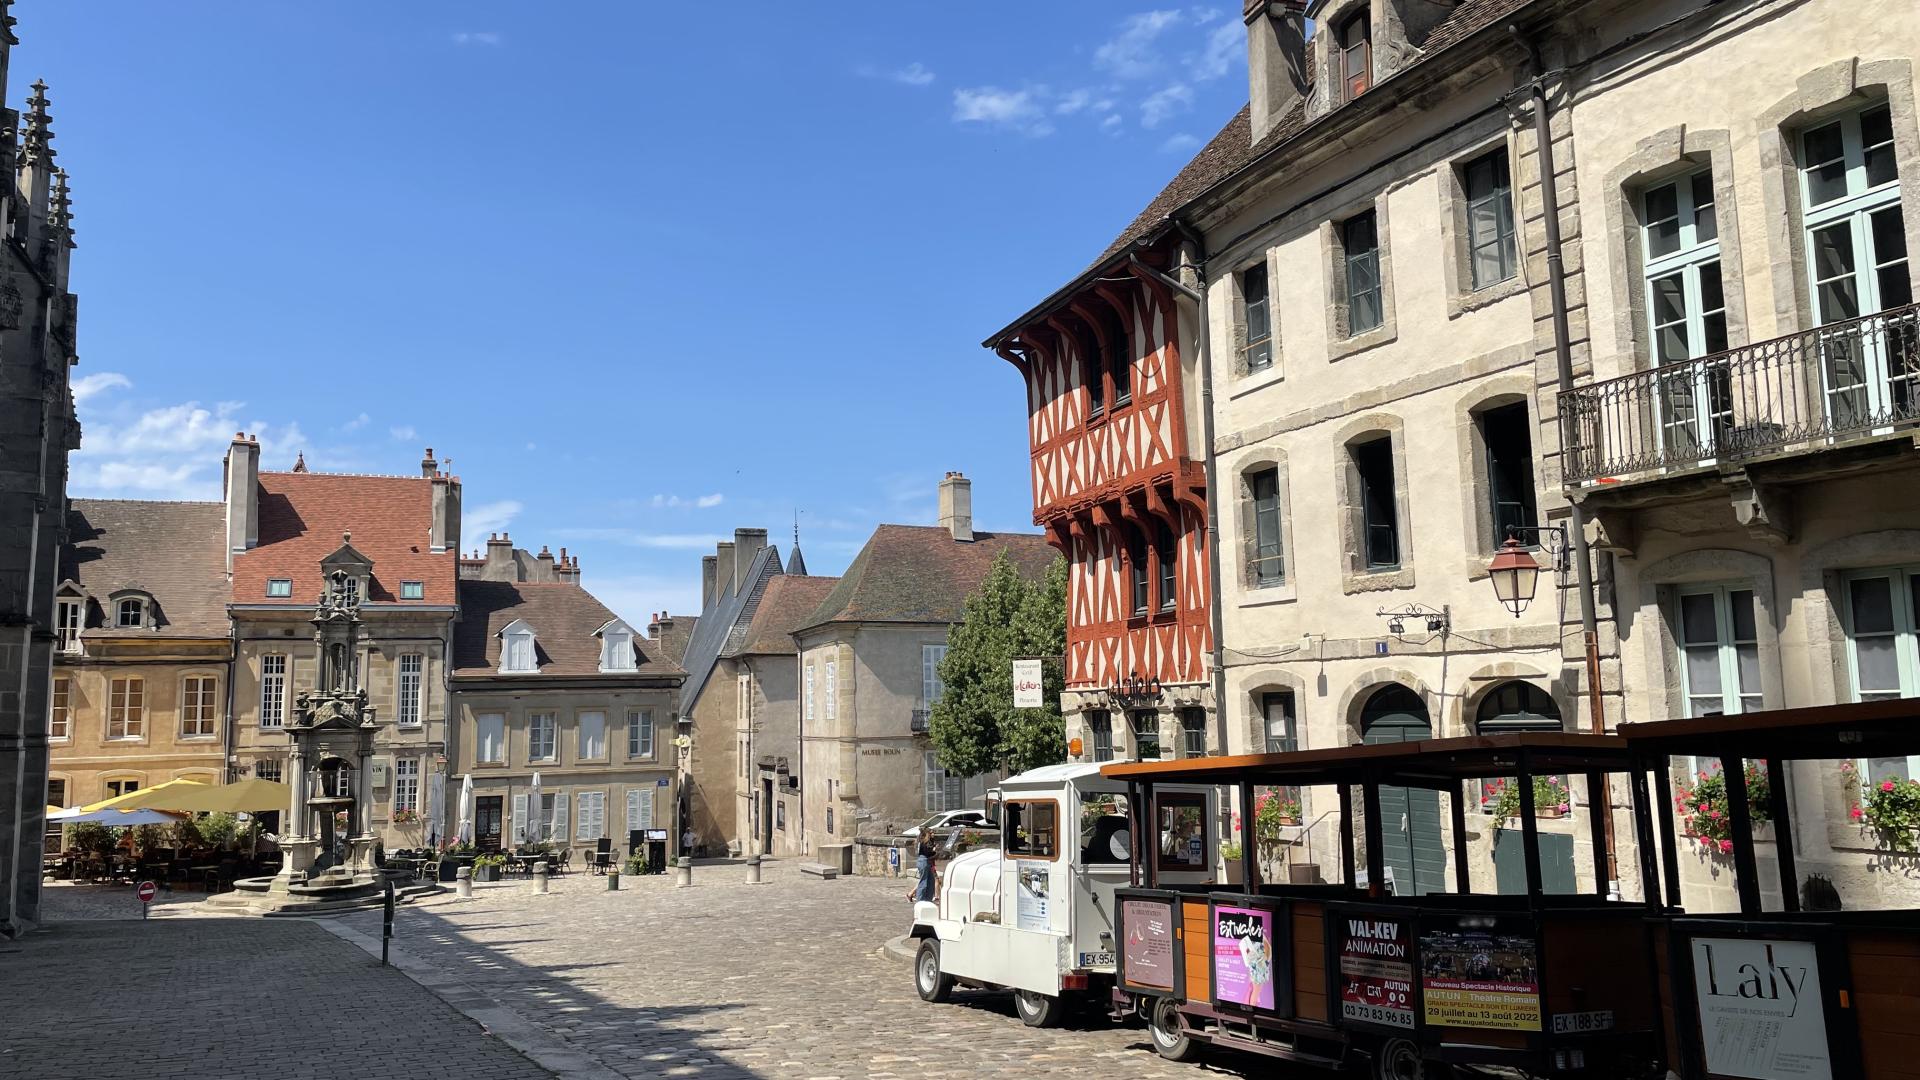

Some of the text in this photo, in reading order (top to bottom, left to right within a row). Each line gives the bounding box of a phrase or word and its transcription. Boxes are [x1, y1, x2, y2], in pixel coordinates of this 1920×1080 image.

[1219, 916, 1264, 938] Estivales
[1348, 919, 1398, 940] VAL-KEV
[1345, 940, 1404, 958] ANIMATION
[1384, 981, 1410, 992] AUTUN
[1430, 981, 1531, 993] Nouveau Spectacle Historique
[1701, 944, 1807, 1018] Laly
[1427, 992, 1460, 1000] AUTUN
[1503, 995, 1537, 1004] Romain
[1449, 1001, 1485, 1009] SPECTACLE
[1345, 1004, 1411, 1025] 03 73 83 96 85
[1428, 1007, 1440, 1016] 29
[1441, 1008, 1466, 1018] juillet
[1492, 1011, 1512, 1020] août
[1514, 1012, 1538, 1022] 2022
[1445, 1018, 1519, 1028] www.augustodunum.fr
